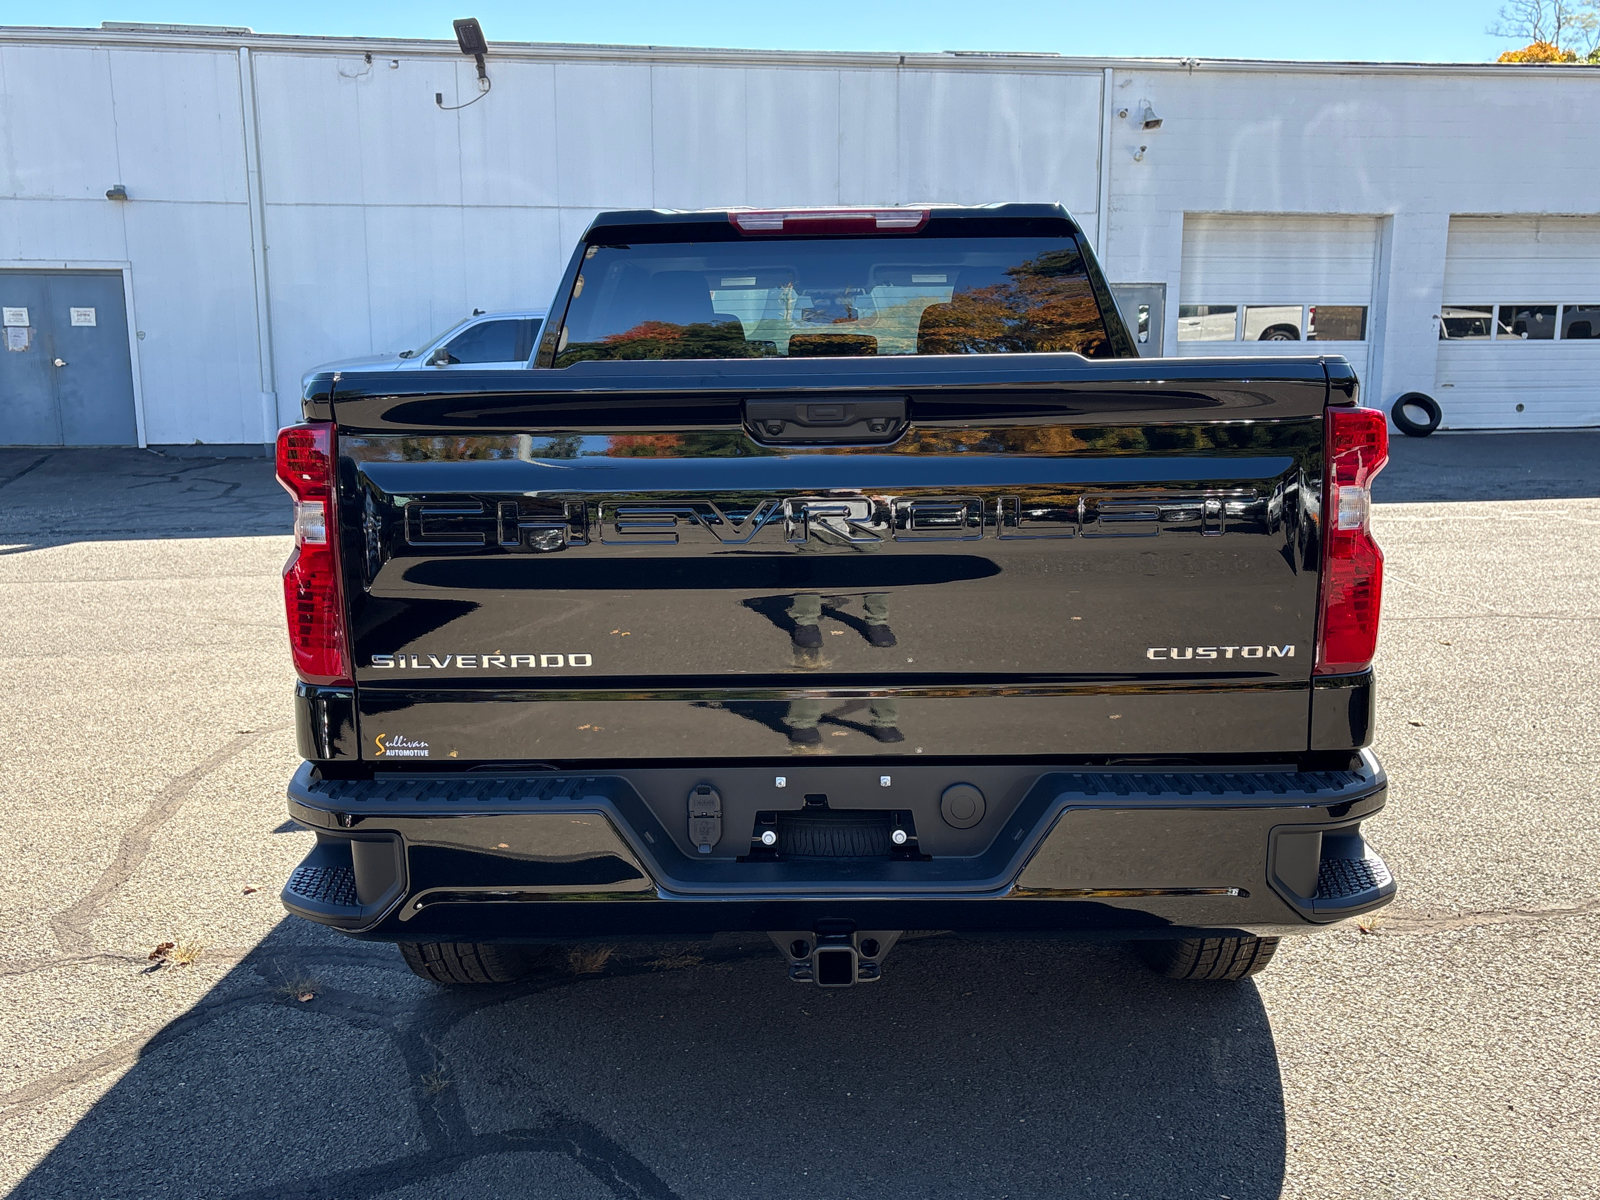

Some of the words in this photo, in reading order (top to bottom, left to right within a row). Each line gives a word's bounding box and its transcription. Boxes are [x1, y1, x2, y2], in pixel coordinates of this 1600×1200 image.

[404, 488, 1258, 546] CHEVROLET
[1146, 644, 1296, 660] CUSTOM
[371, 653, 594, 669] SILVERADO
[375, 733, 429, 756] Sullivan
[385, 749, 429, 757] AUTOMOTIVE
